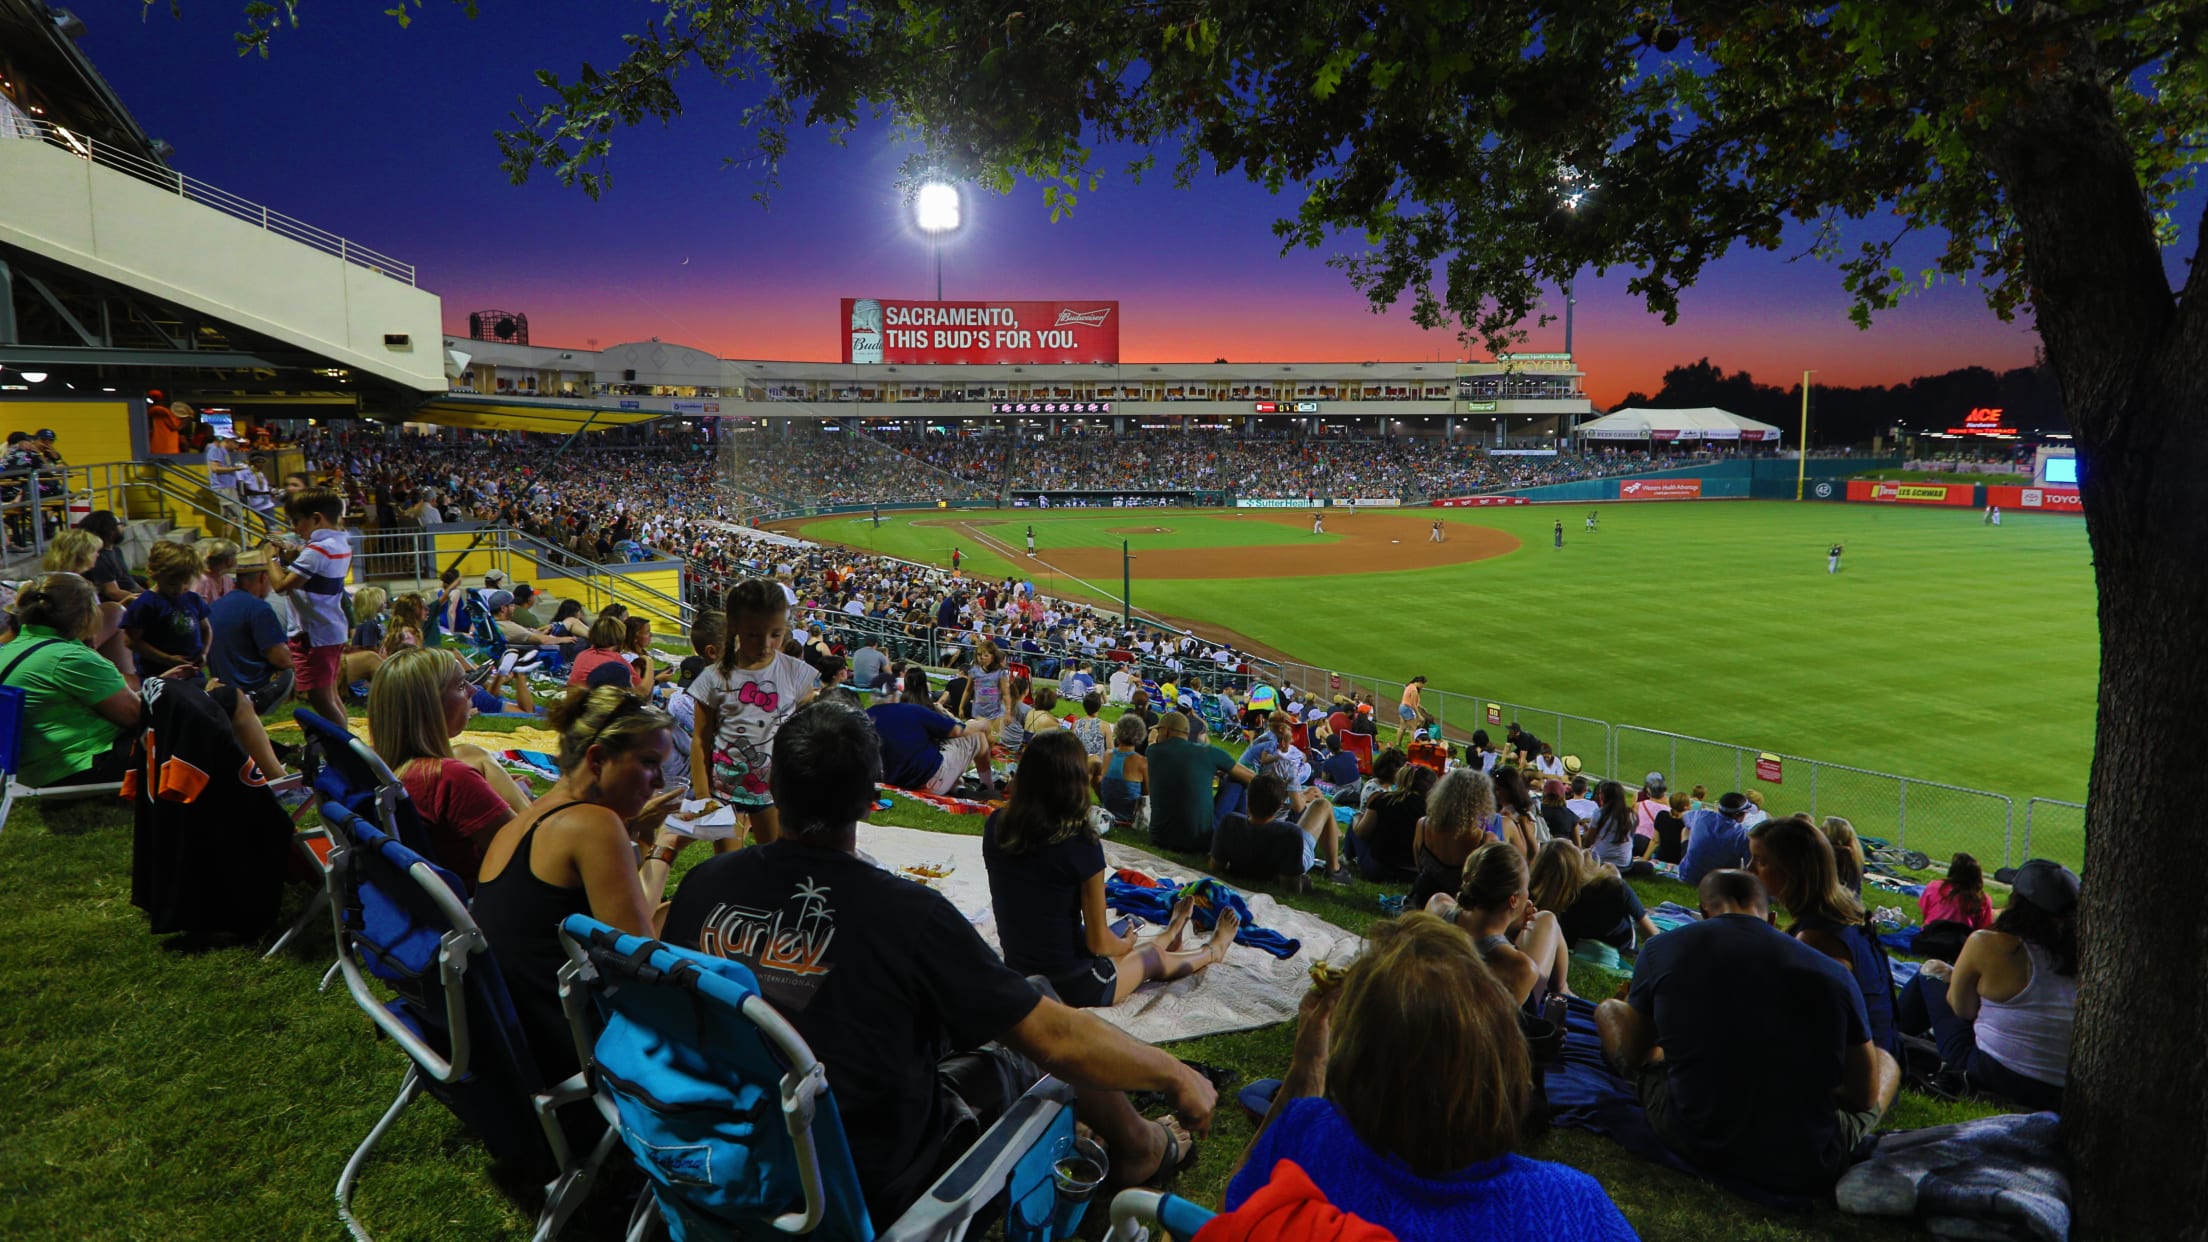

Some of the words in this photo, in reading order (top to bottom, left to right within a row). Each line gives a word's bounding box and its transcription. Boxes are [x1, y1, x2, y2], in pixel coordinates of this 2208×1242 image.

[886, 307, 1019, 329] SACRAMENTO,
[1059, 312, 1105, 322] Budweiser
[886, 330, 929, 349] THIS
[934, 330, 990, 349] BUD'S
[995, 330, 1031, 349] FOR
[1035, 330, 1078, 349] YOU.
[1543, 360, 1571, 371] CLUB
[1965, 408, 2003, 421] ACE
[1256, 499, 1284, 507] Sutter
